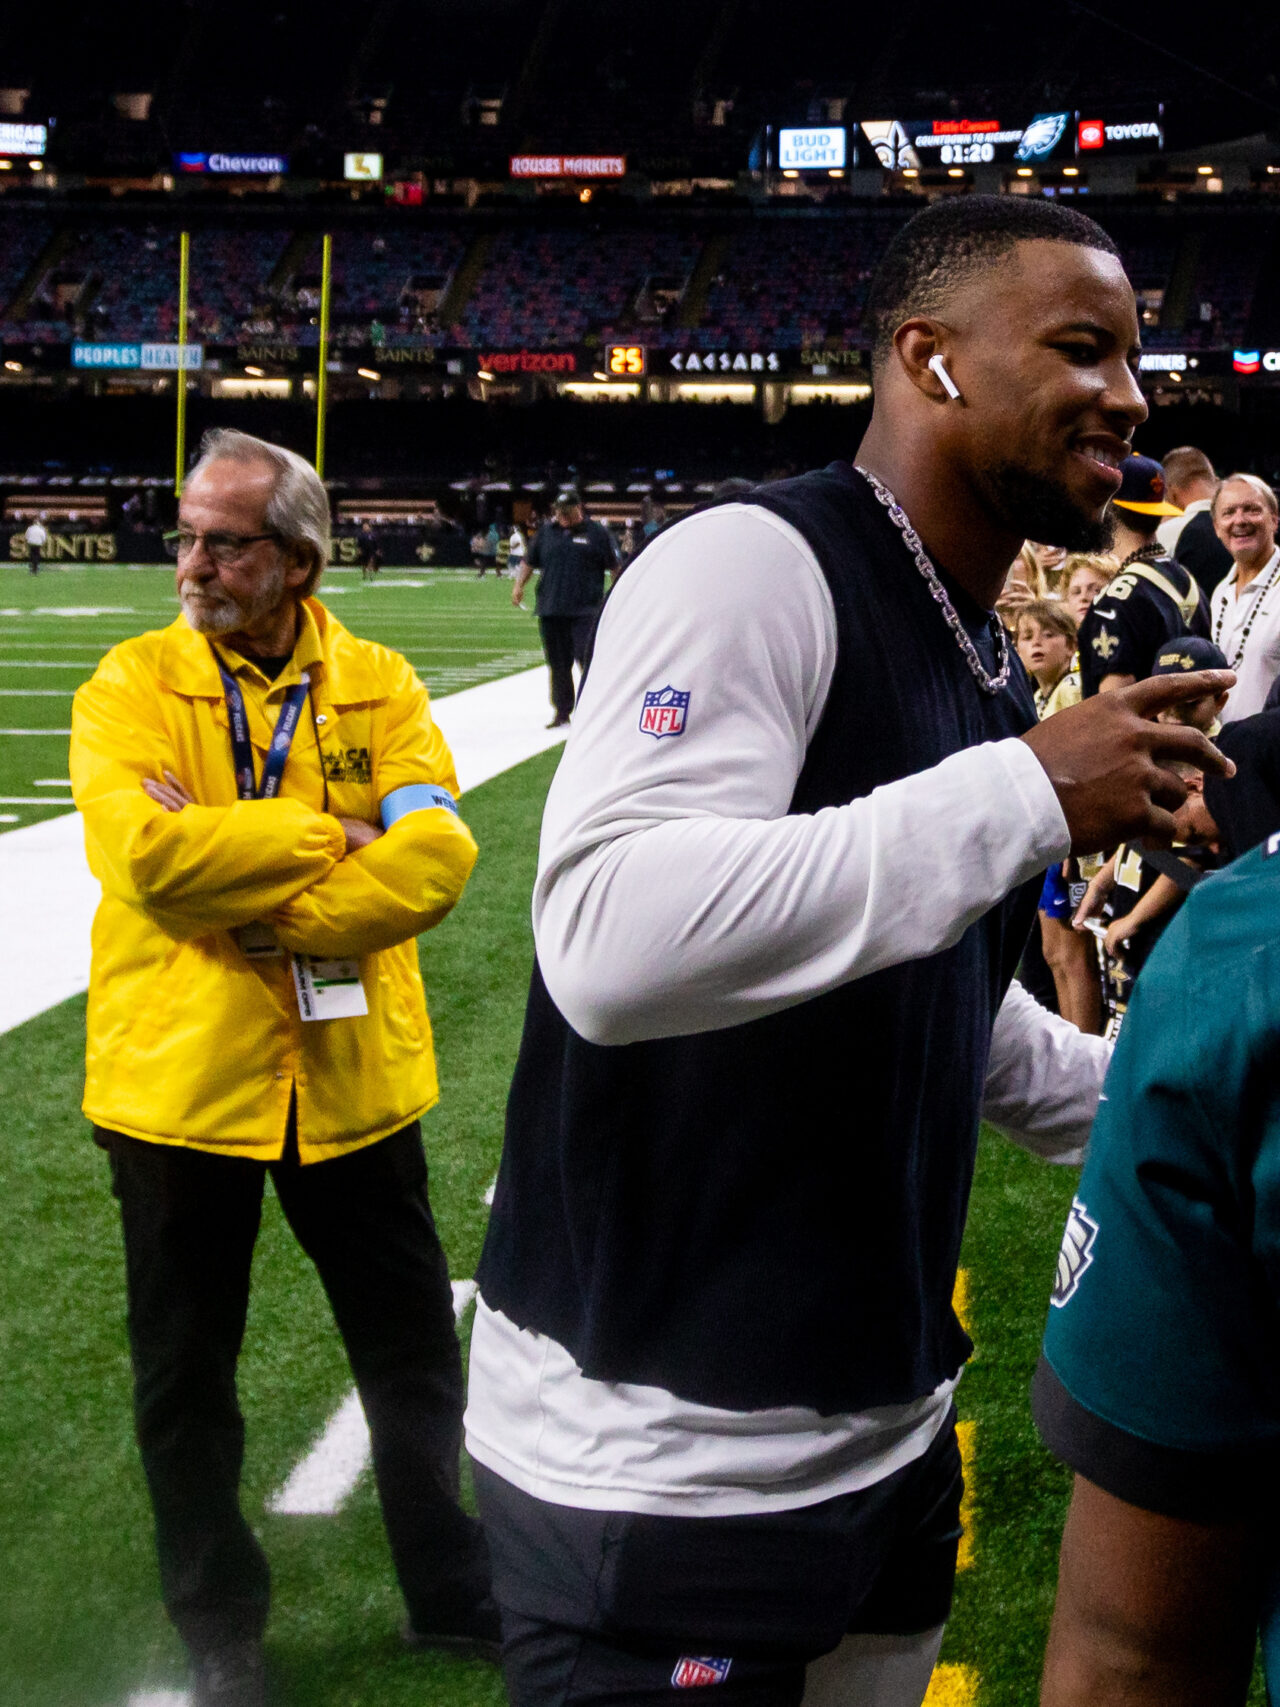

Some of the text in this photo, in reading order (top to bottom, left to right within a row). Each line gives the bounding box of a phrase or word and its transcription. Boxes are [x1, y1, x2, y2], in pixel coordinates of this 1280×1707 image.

[1104, 121, 1160, 140] TOYOTA
[791, 134, 831, 147] BUD
[208, 153, 282, 172] Chevron
[783, 148, 838, 162] LIGHT
[511, 158, 560, 173] ROUSES
[563, 158, 623, 174] MARKETS
[73, 347, 138, 365] PEOPLES
[477, 349, 576, 372] verizon
[610, 346, 643, 374] 25
[670, 352, 780, 372] CAESARS
[643, 708, 682, 733] NFL
